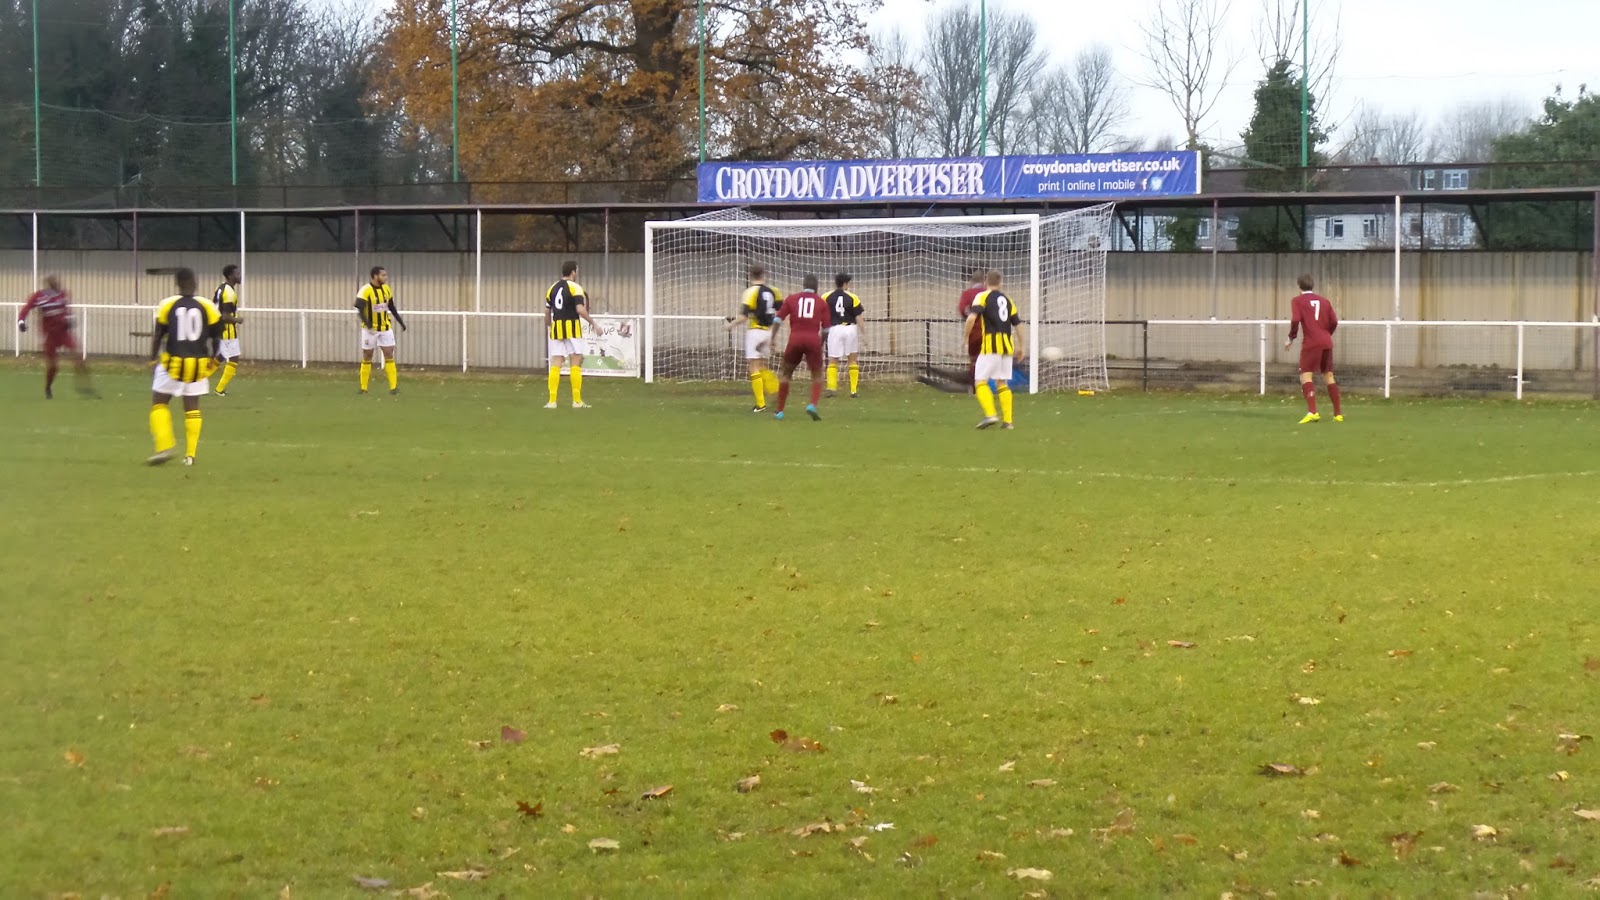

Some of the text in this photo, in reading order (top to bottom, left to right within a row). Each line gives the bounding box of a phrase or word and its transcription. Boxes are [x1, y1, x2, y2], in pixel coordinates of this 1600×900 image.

[1023, 157, 1180, 176] croydonadvertiser.co.uk
[715, 162, 985, 200] CROYDON ADVERTISER
[1038, 180, 1060, 194] print
[1067, 179, 1096, 192] online
[1103, 178, 1136, 191] mobile
[554, 286, 564, 310] 6
[797, 297, 816, 319] 10
[835, 295, 846, 317] 4
[996, 295, 1009, 322] 8
[1309, 299, 1321, 321] 7
[174, 306, 203, 341] 10
